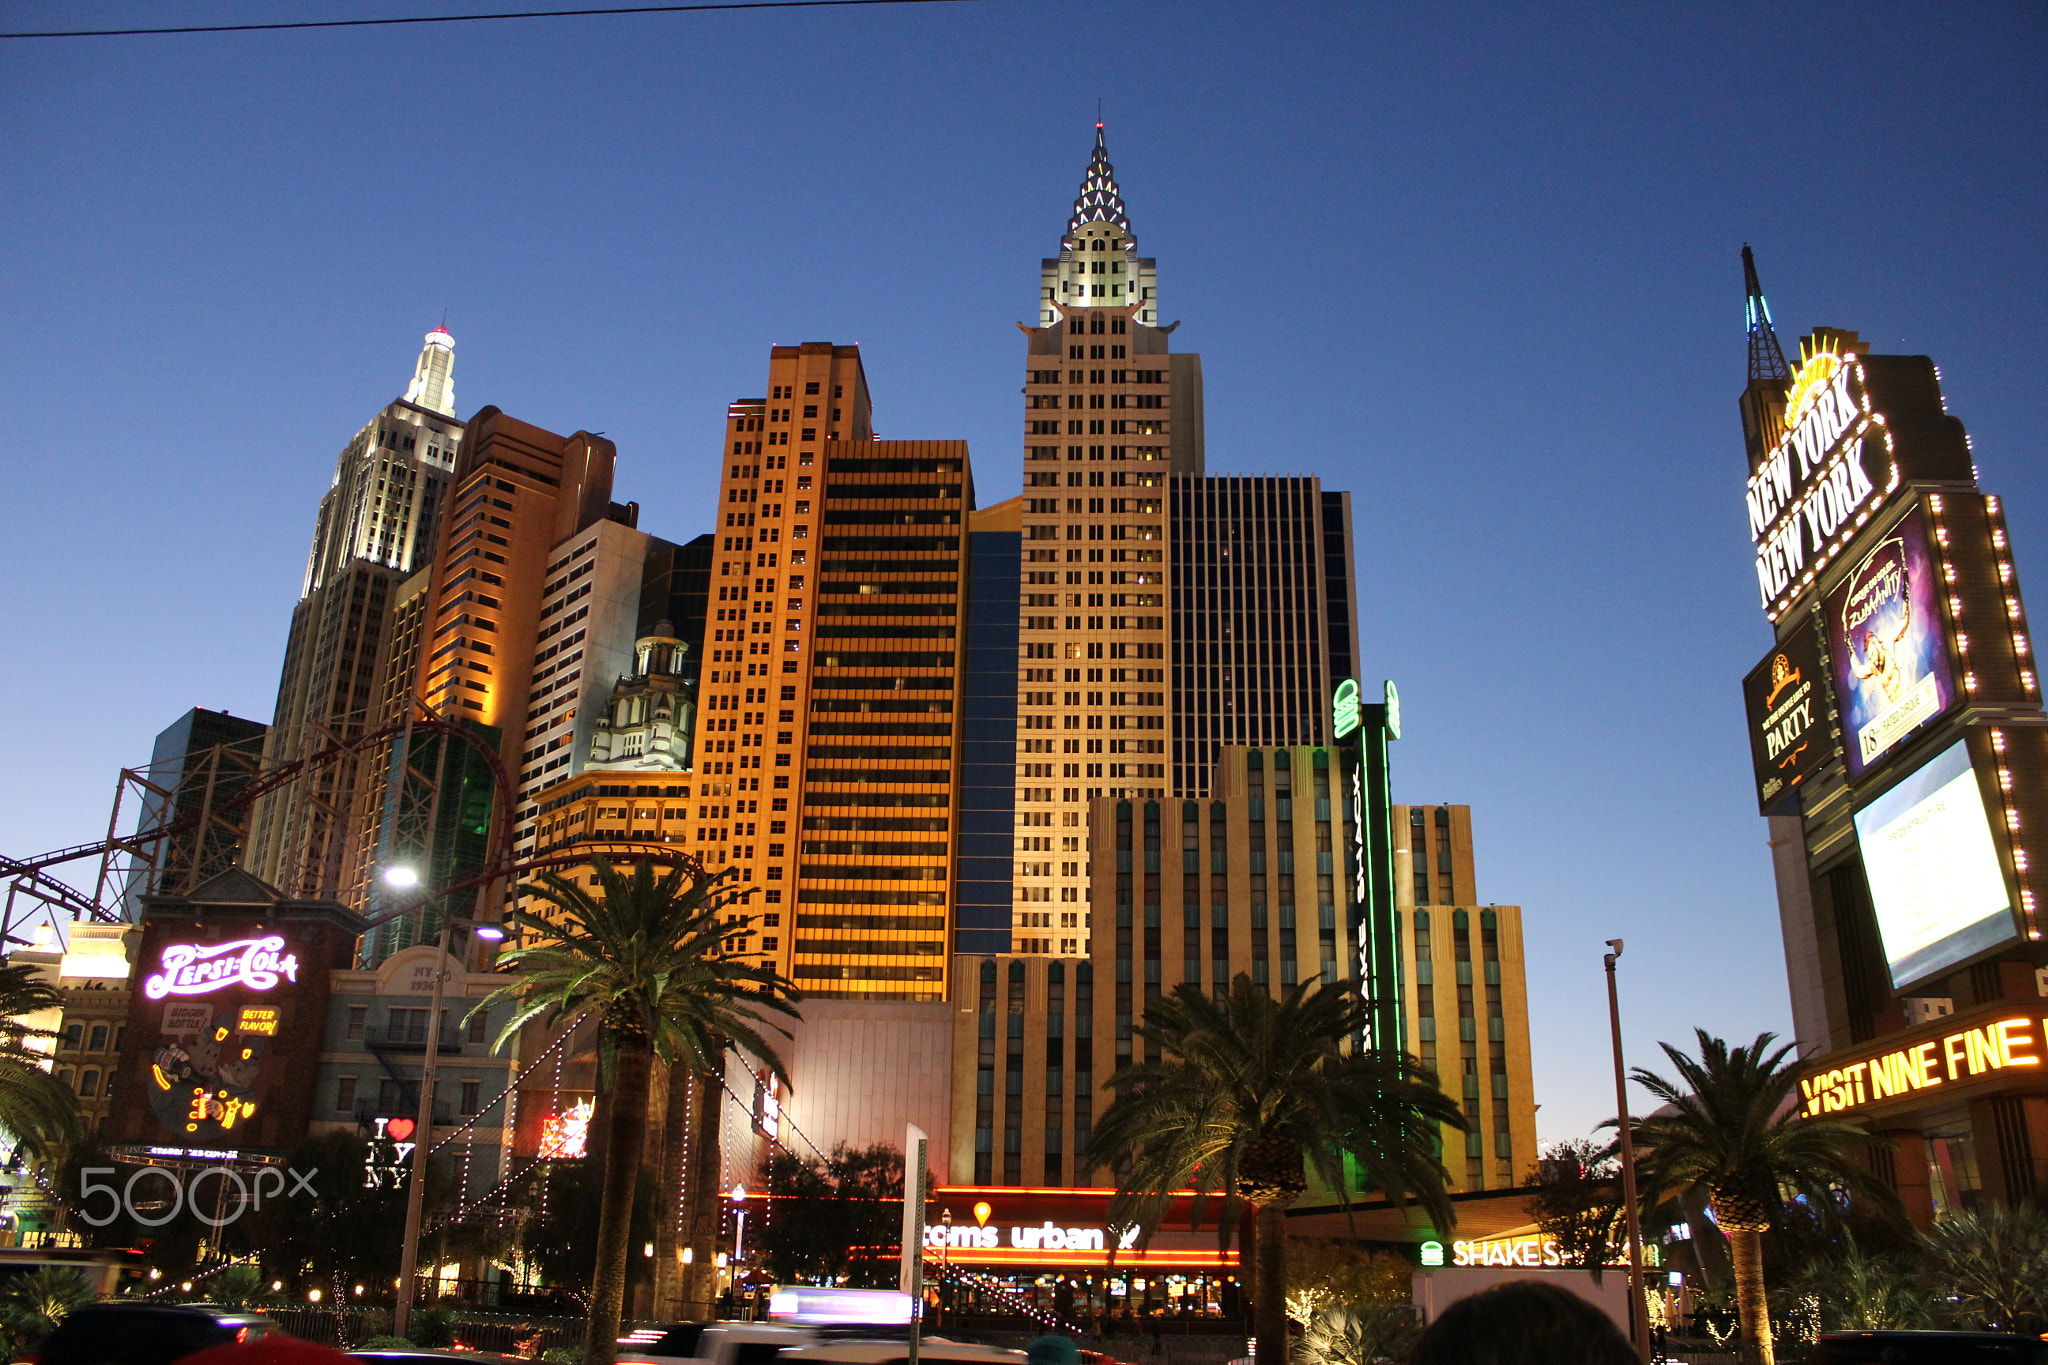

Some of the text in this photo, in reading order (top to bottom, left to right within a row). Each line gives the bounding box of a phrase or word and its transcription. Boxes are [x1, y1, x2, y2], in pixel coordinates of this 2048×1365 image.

[1745, 364, 1859, 542] NEW YORK
[1755, 438, 1874, 610] NEW YORK
[1849, 566, 1902, 630] ZUMANITY
[1765, 697, 1815, 761] PARTY.
[1352, 762, 1366, 904] SHACK
[168, 1018, 208, 1032] BOTTLE!
[171, 1007, 207, 1018] BIGGER
[241, 1009, 275, 1020] BETTER
[239, 1019, 278, 1036] FLAVOR!
[1869, 1041, 1942, 1100] NINE
[1943, 1018, 2040, 1081] FINE
[374, 1117, 389, 1139] I
[1011, 1221, 1103, 1250] urban
[1452, 1240, 1540, 1267] SHAKE
